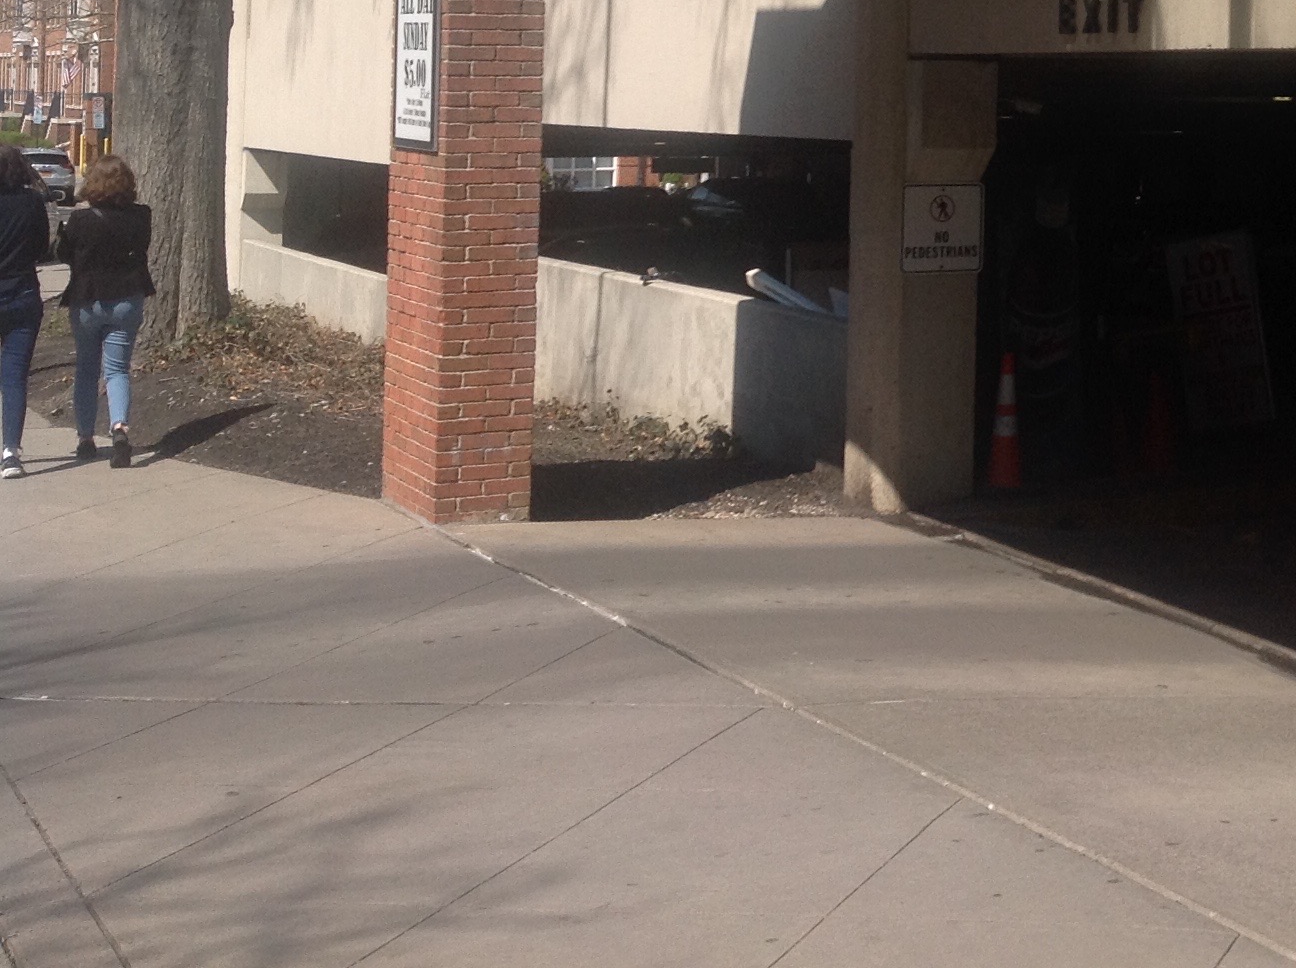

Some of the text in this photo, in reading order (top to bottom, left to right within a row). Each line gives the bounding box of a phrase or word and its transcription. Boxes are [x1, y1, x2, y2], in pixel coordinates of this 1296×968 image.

[403, 22, 429, 50] SUNDAY
[404, 58, 426, 88] $5.00
[934, 231, 949, 243] NO
[905, 245, 977, 259] PEDESTRIANS
